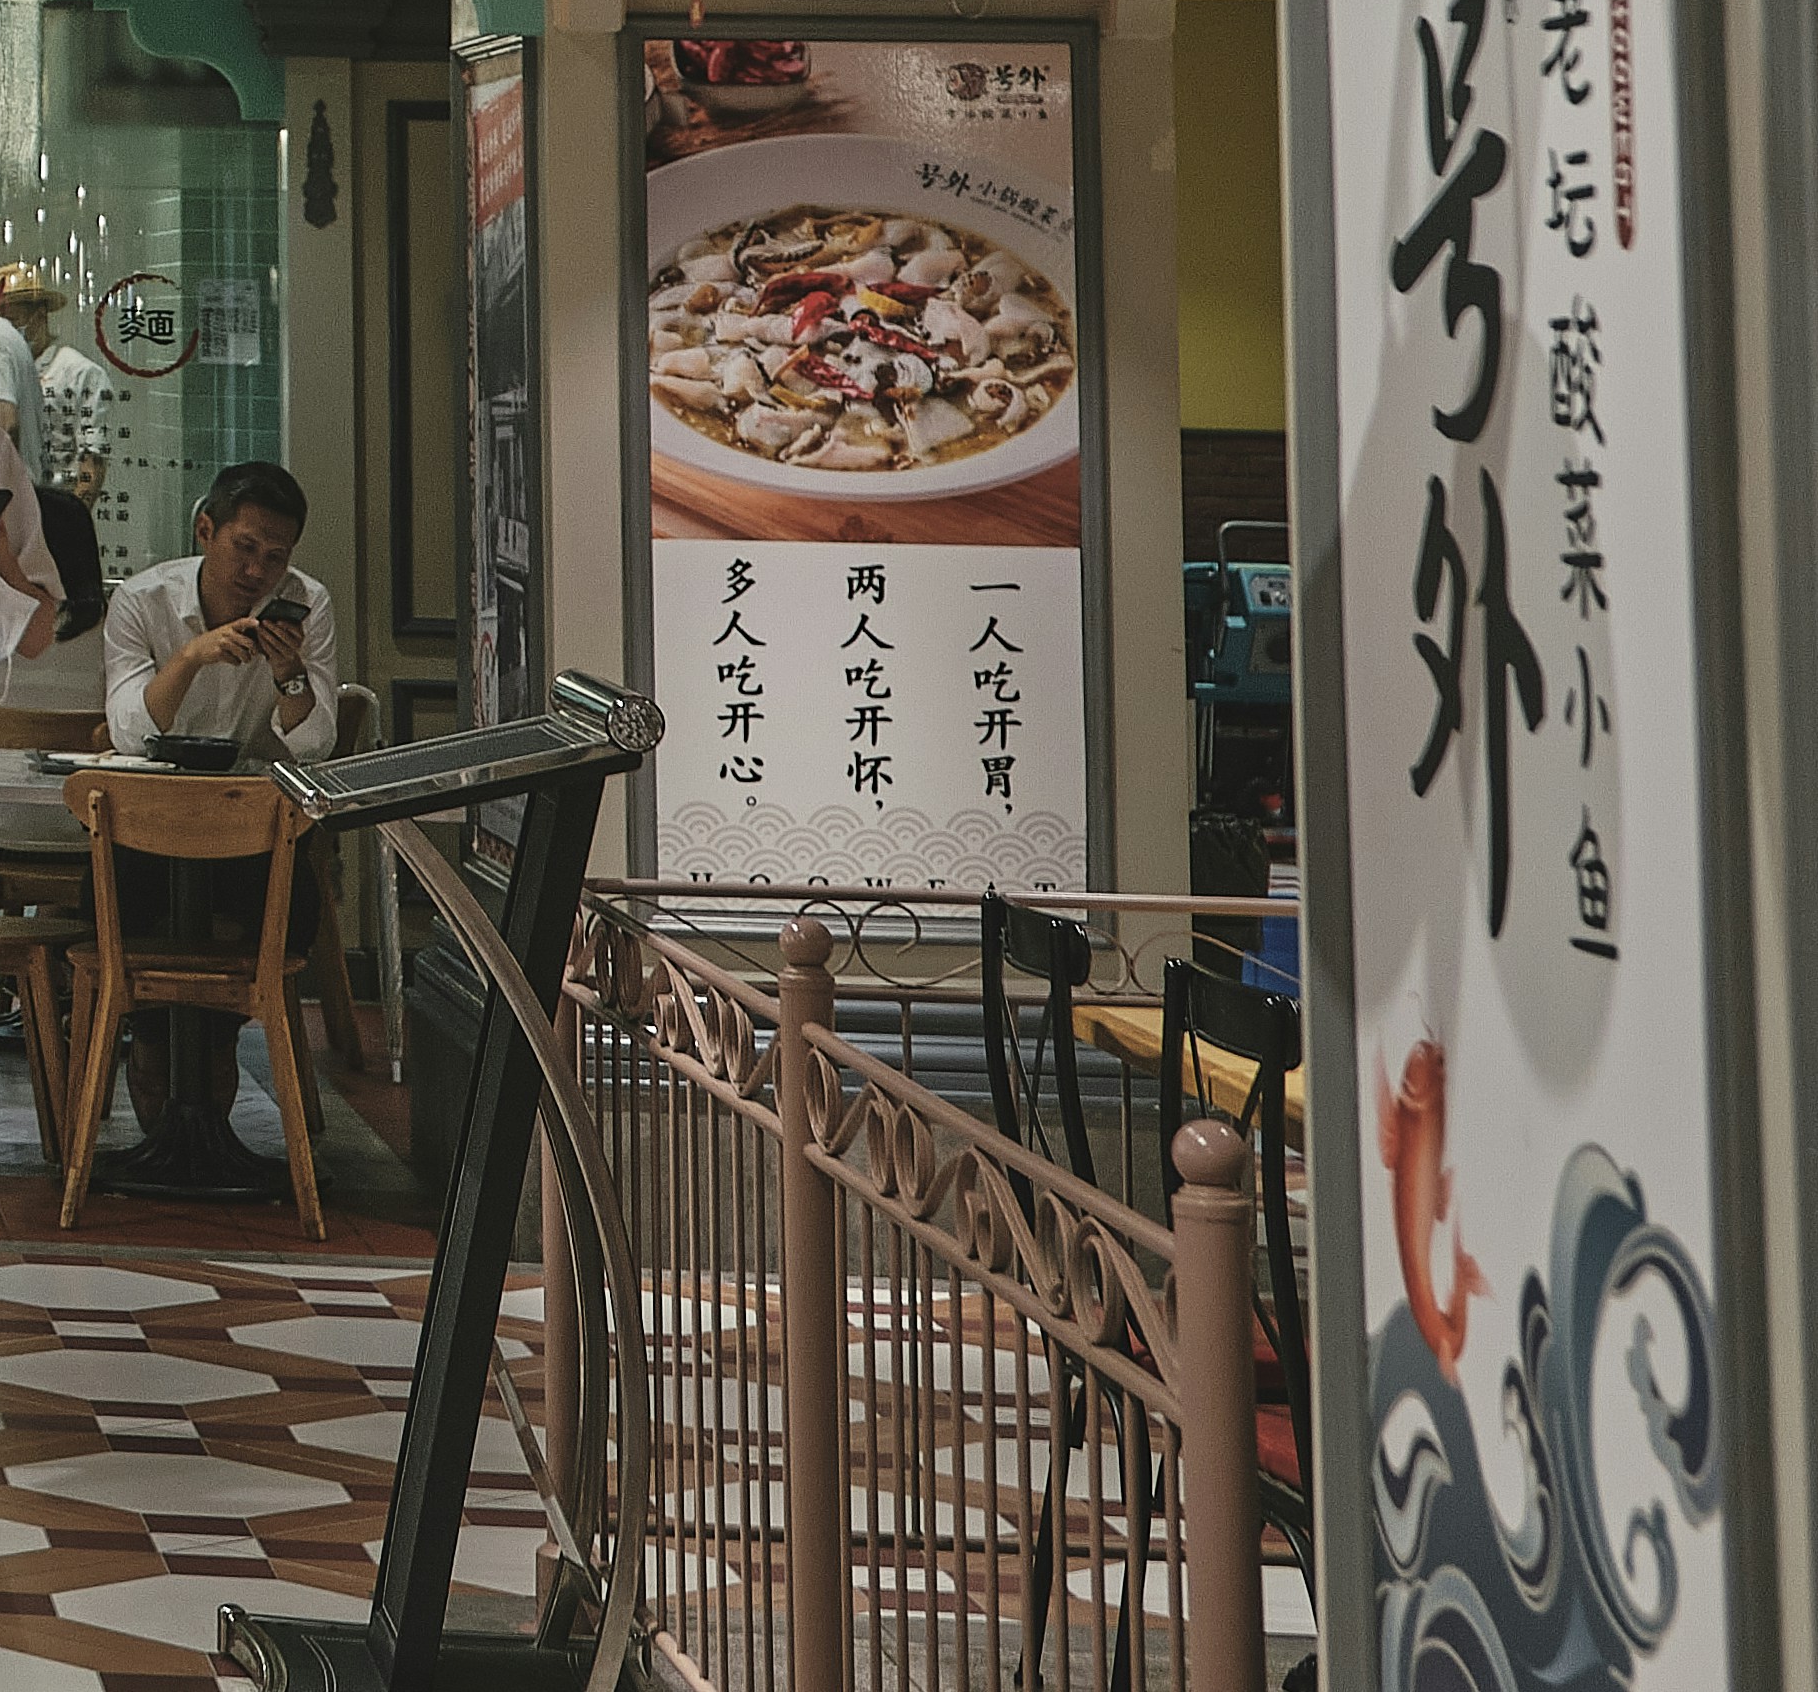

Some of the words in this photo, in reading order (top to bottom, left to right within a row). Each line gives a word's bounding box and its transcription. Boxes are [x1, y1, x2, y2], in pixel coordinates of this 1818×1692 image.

[914, 162, 972, 198] 号外
[118, 306, 176, 345] 麵
[712, 557, 767, 807] 多人吃开心。
[840, 564, 895, 810] 两人吃开怀，
[969, 582, 1024, 814] 一人吃开胃，
